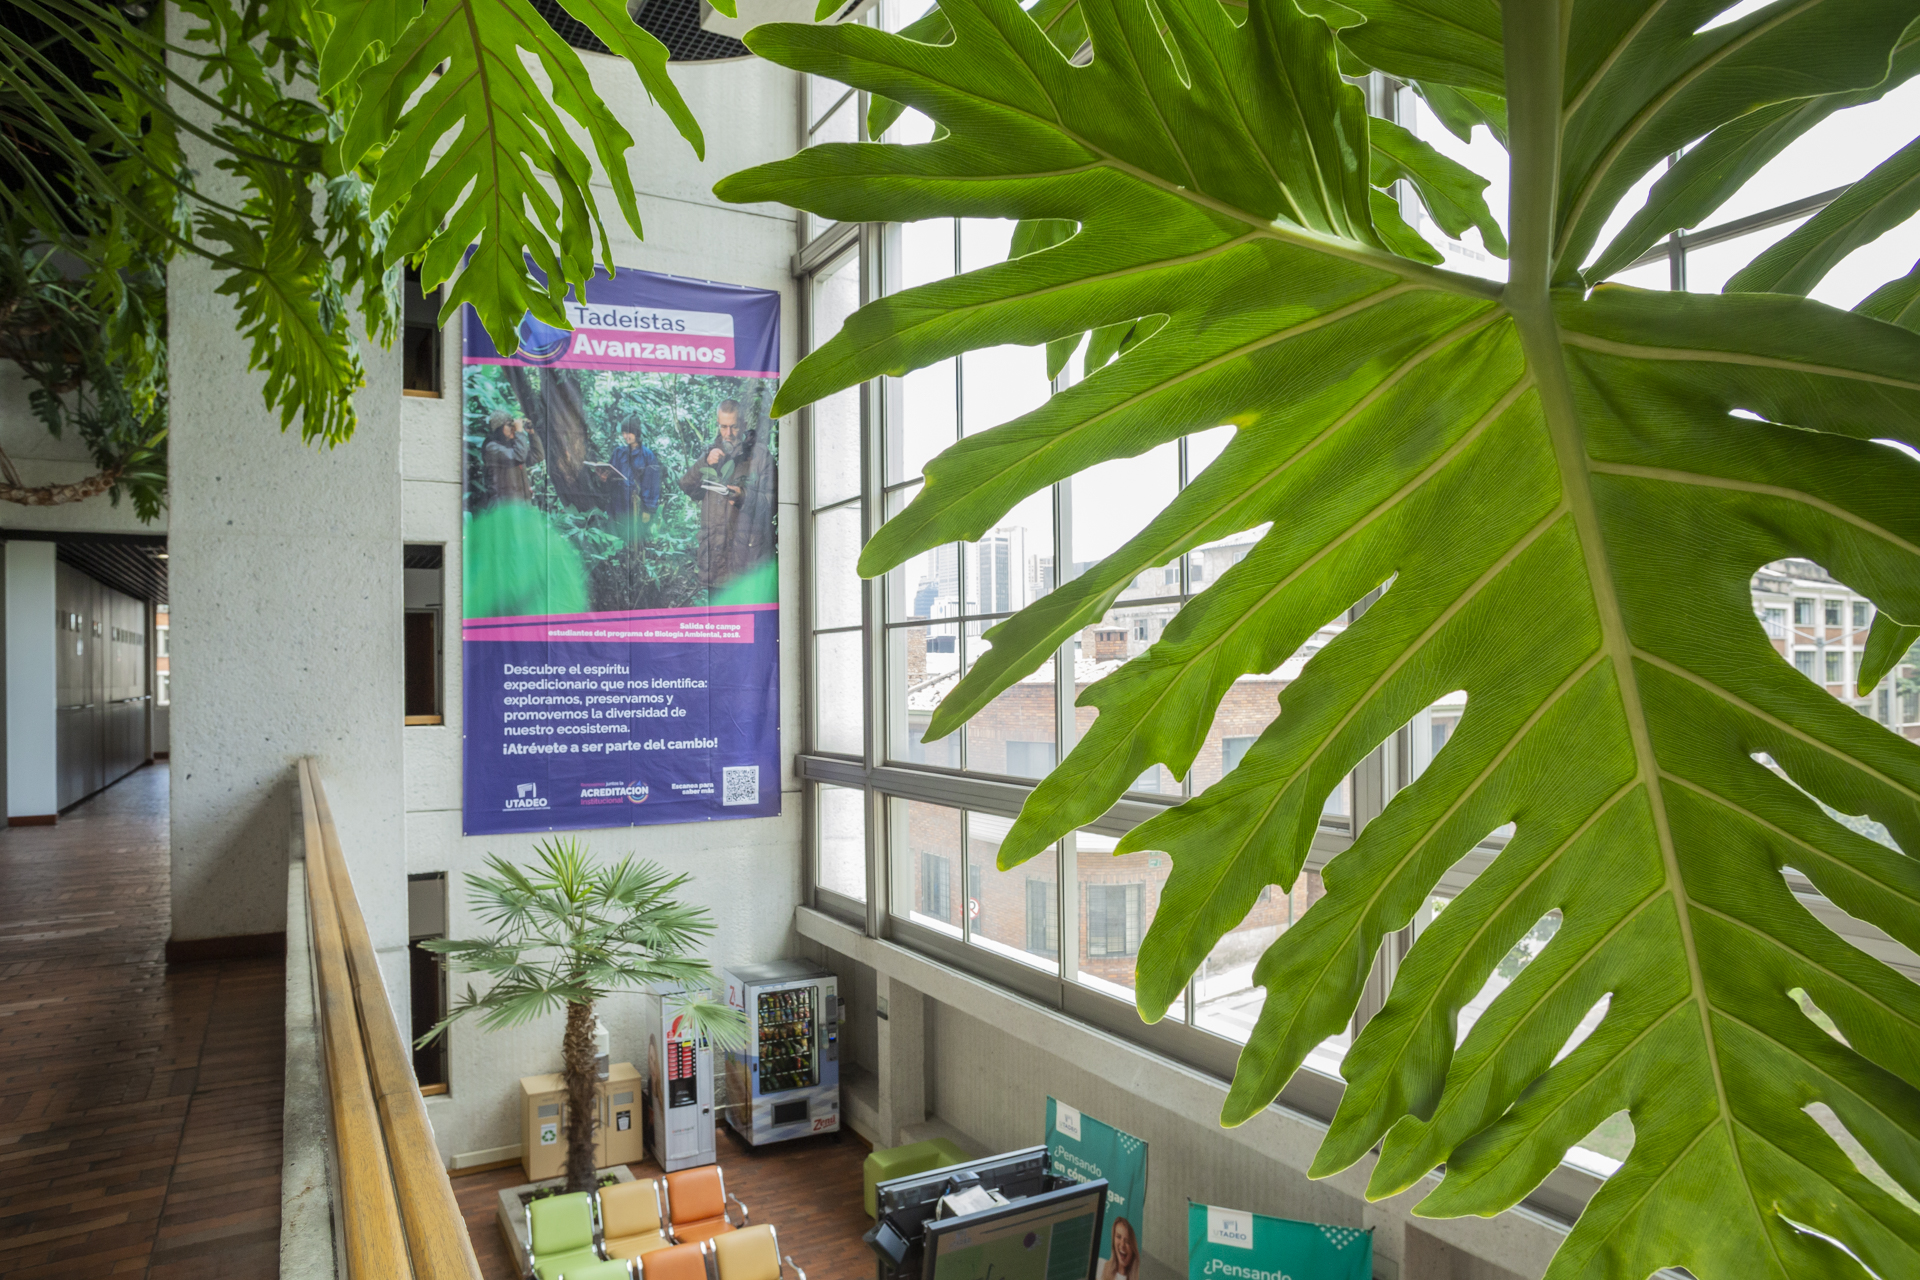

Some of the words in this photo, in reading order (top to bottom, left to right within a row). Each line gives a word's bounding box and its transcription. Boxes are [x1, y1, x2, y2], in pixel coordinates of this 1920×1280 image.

[574, 306, 686, 332] Tadeístas
[573, 333, 726, 364] Avanzamos
[680, 622, 703, 630] Salida
[705, 622, 714, 630] de
[716, 623, 741, 631] campo
[684, 631, 722, 639] Ambiental,
[504, 664, 566, 675] Descubre
[569, 664, 581, 674] el
[583, 664, 630, 676] espíritu
[503, 678, 598, 692] expedicionario
[600, 681, 624, 691] que
[627, 680, 649, 689] nos
[651, 677, 708, 689] identifica:
[503, 694, 583, 707] exploramos,
[585, 693, 664, 706] preservamos
[666, 694, 674, 705] y
[504, 709, 588, 723] promovemos
[591, 708, 603, 719] la
[605, 707, 668, 718] diversidad
[670, 707, 687, 717] de
[504, 725, 554, 736] nuestro
[556, 723, 631, 735] ecosistema.
[503, 742, 568, 755] ¡Atrévete
[570, 744, 579, 752] a
[581, 743, 603, 752] ser
[605, 741, 641, 754] parte
[643, 739, 665, 750] del
[667, 737, 718, 749] cambio!
[699, 782, 714, 790] para
[505, 797, 548, 809] UTADEO
[1054, 1145, 1102, 1177] ¿Pensando
[1054, 1161, 1065, 1173] en
[1213, 1229, 1247, 1240] UTADEO
